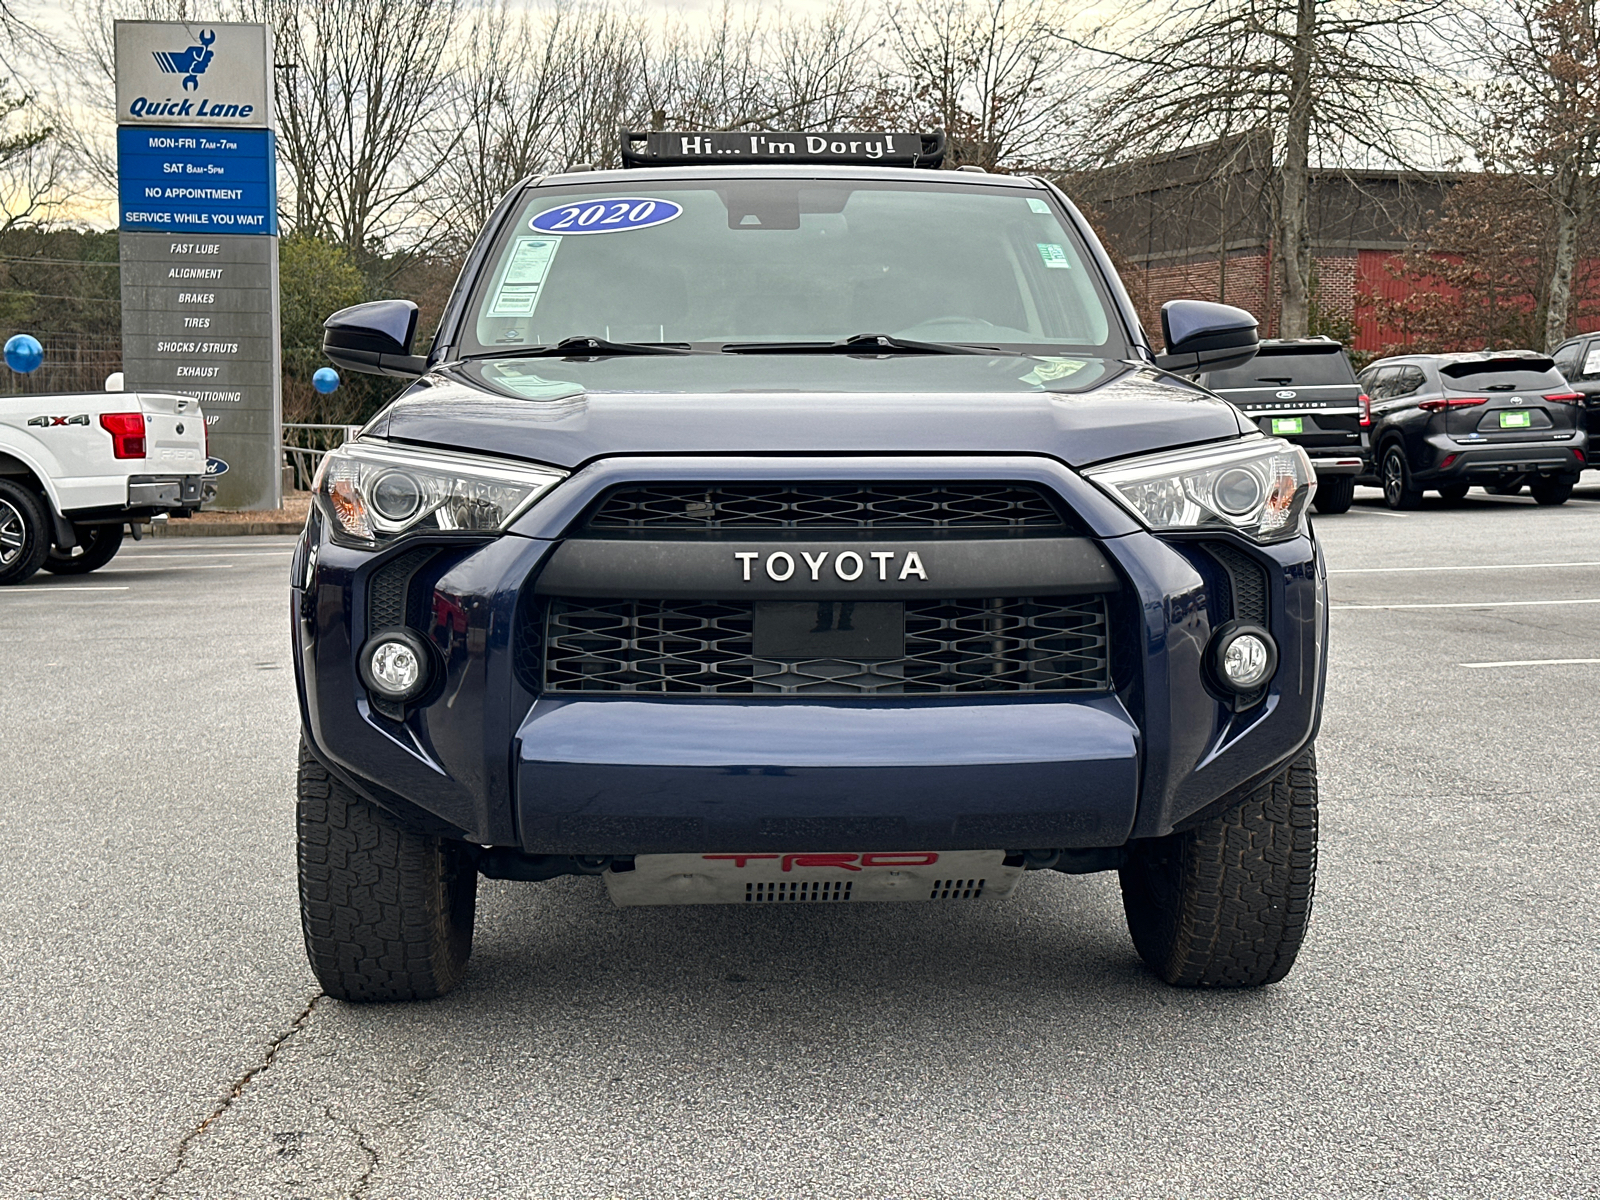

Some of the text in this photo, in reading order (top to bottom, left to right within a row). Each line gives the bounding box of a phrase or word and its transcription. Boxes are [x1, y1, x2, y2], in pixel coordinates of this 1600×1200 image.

[129, 97, 254, 118] Quick Lane
[149, 138, 238, 150] MON-FRI 7AM-7PM
[680, 135, 896, 159] Hi... I'm Dory!
[163, 163, 225, 175] SAT 8AM-5PM
[145, 188, 243, 200] NO APPOINTMENT
[125, 212, 264, 225] SERVICE WHILE YOU WAIT
[549, 201, 656, 230] 2020
[170, 243, 220, 255] FAST LUBE
[168, 268, 223, 279] ALIGNMENT
[178, 293, 215, 304] BRAKES
[184, 318, 211, 328] TIRES
[176, 366, 220, 377] EXHAUST
[177, 391, 241, 402] DITIONING
[1246, 402, 1327, 410] EXPEDITION
[205, 415, 219, 426] UP
[734, 550, 929, 582] TOYOTA
[701, 851, 939, 872] TRD
